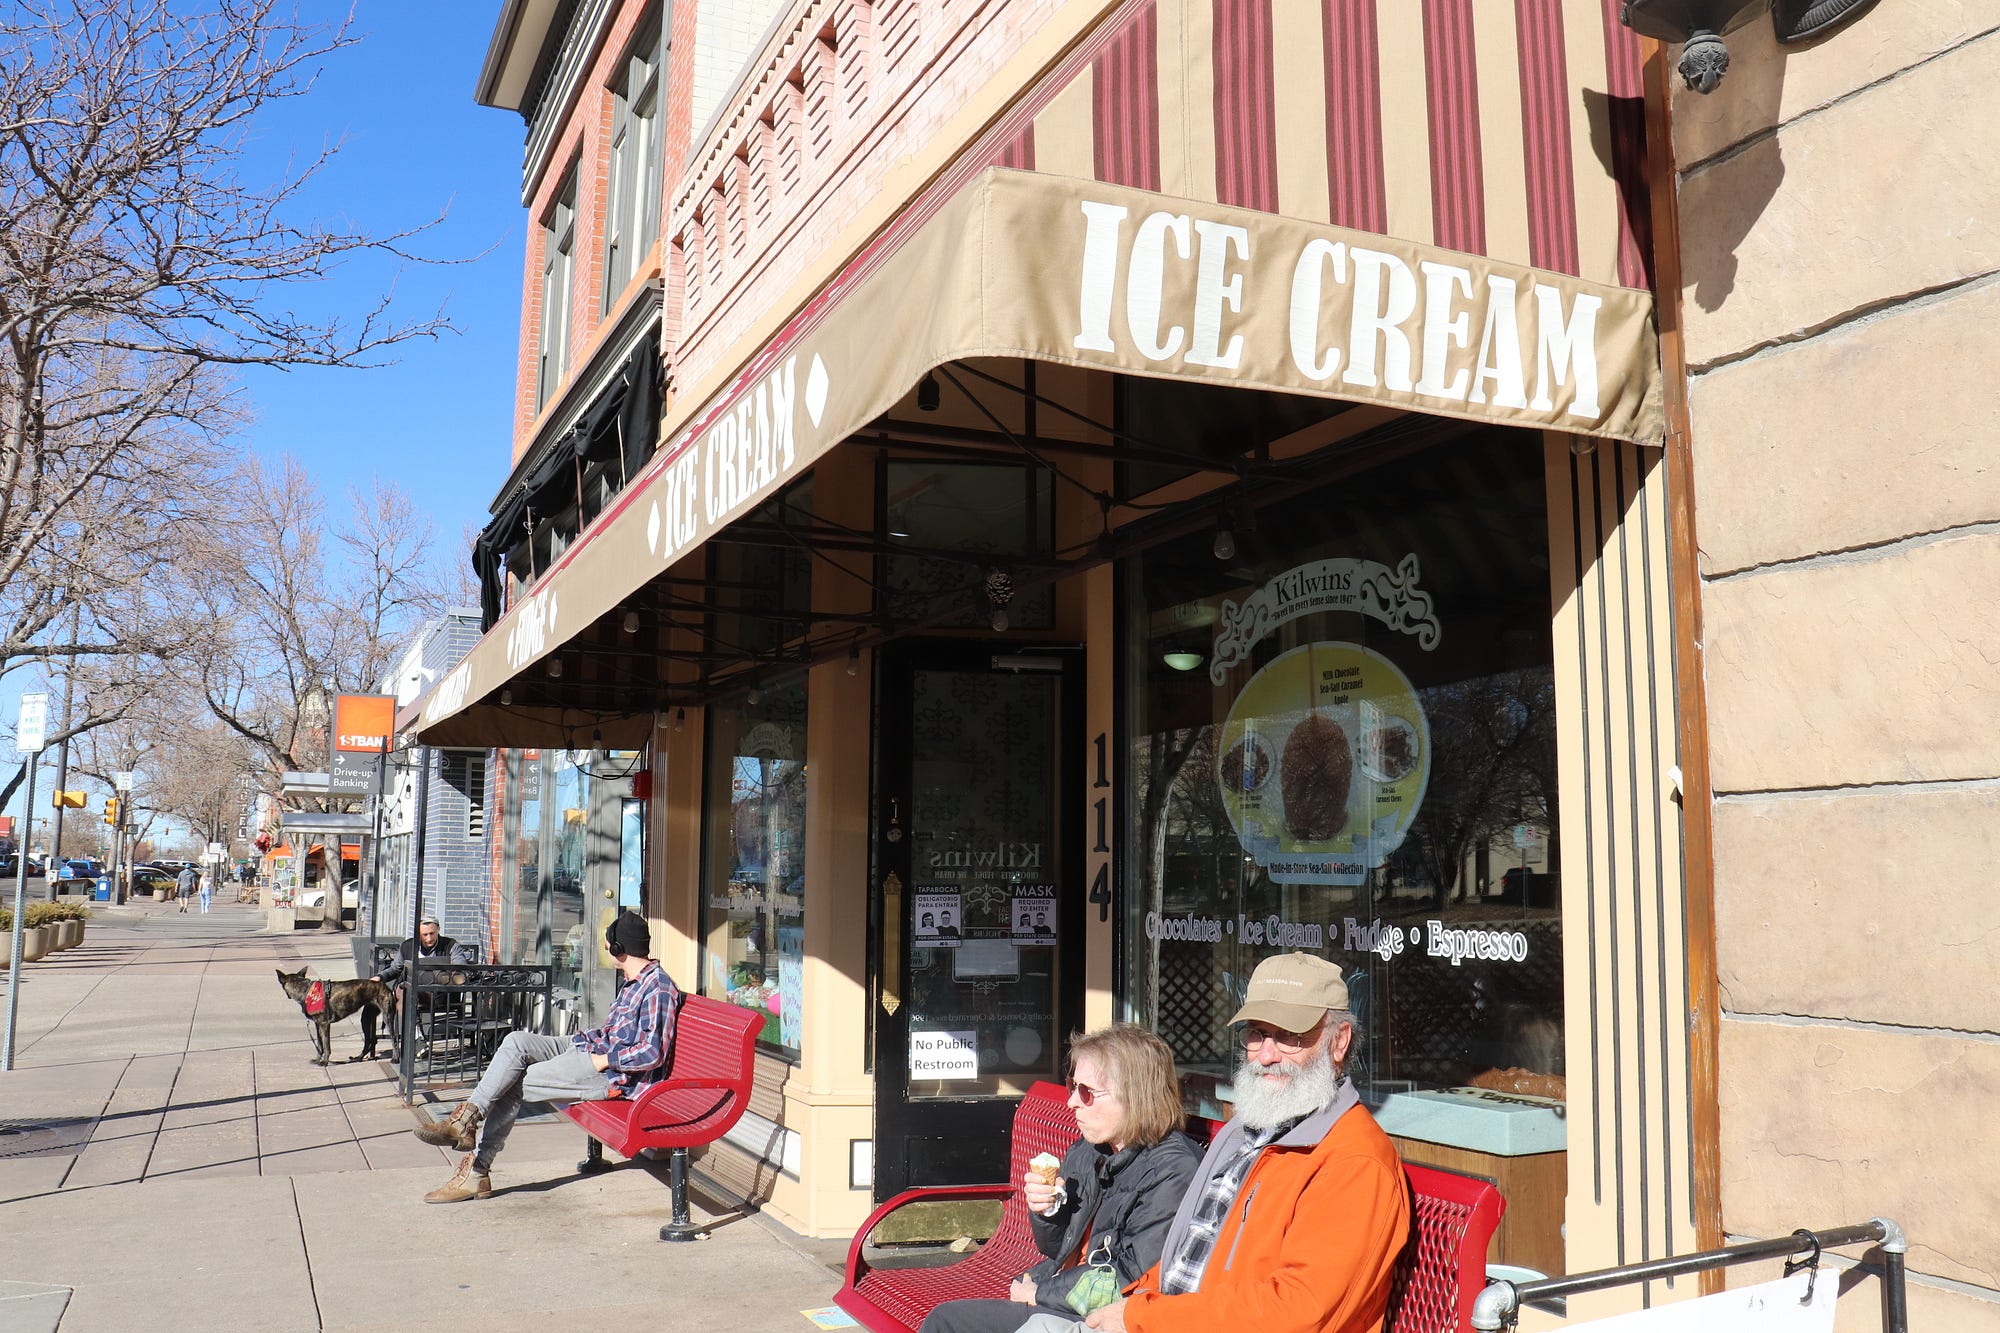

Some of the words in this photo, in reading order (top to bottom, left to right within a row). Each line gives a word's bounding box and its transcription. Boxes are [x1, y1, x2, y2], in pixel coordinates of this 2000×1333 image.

[1074, 200, 1249, 369] ICE
[1290, 238, 1602, 419] CREAM
[664, 445, 699, 560] ICE
[705, 354, 796, 525] CREAM
[1275, 566, 1351, 606] Kilwins
[1334, 666, 1360, 679] Chocolate
[1320, 681, 1340, 695] Sea-Salt
[1341, 678, 1363, 691] Caramel
[1334, 694, 1349, 706] Apple
[334, 767, 373, 778] Drive-up
[333, 778, 369, 789] Banking
[1089, 732, 1111, 922] 1114
[1270, 862, 1308, 874] Made-in-Store
[1309, 863, 1332, 874] Sea-Salt
[1333, 862, 1364, 875] Collection
[1015, 885, 1054, 897] MASK
[1145, 911, 1222, 943] Chocolates
[1239, 913, 1262, 945] Ice
[1266, 914, 1323, 949] Cream
[1343, 917, 1405, 961] Fudge
[1427, 919, 1527, 966] Espresso
[915, 1040, 933, 1050] No
[937, 1038, 974, 1049] Public
[915, 1059, 974, 1070] Restroom
